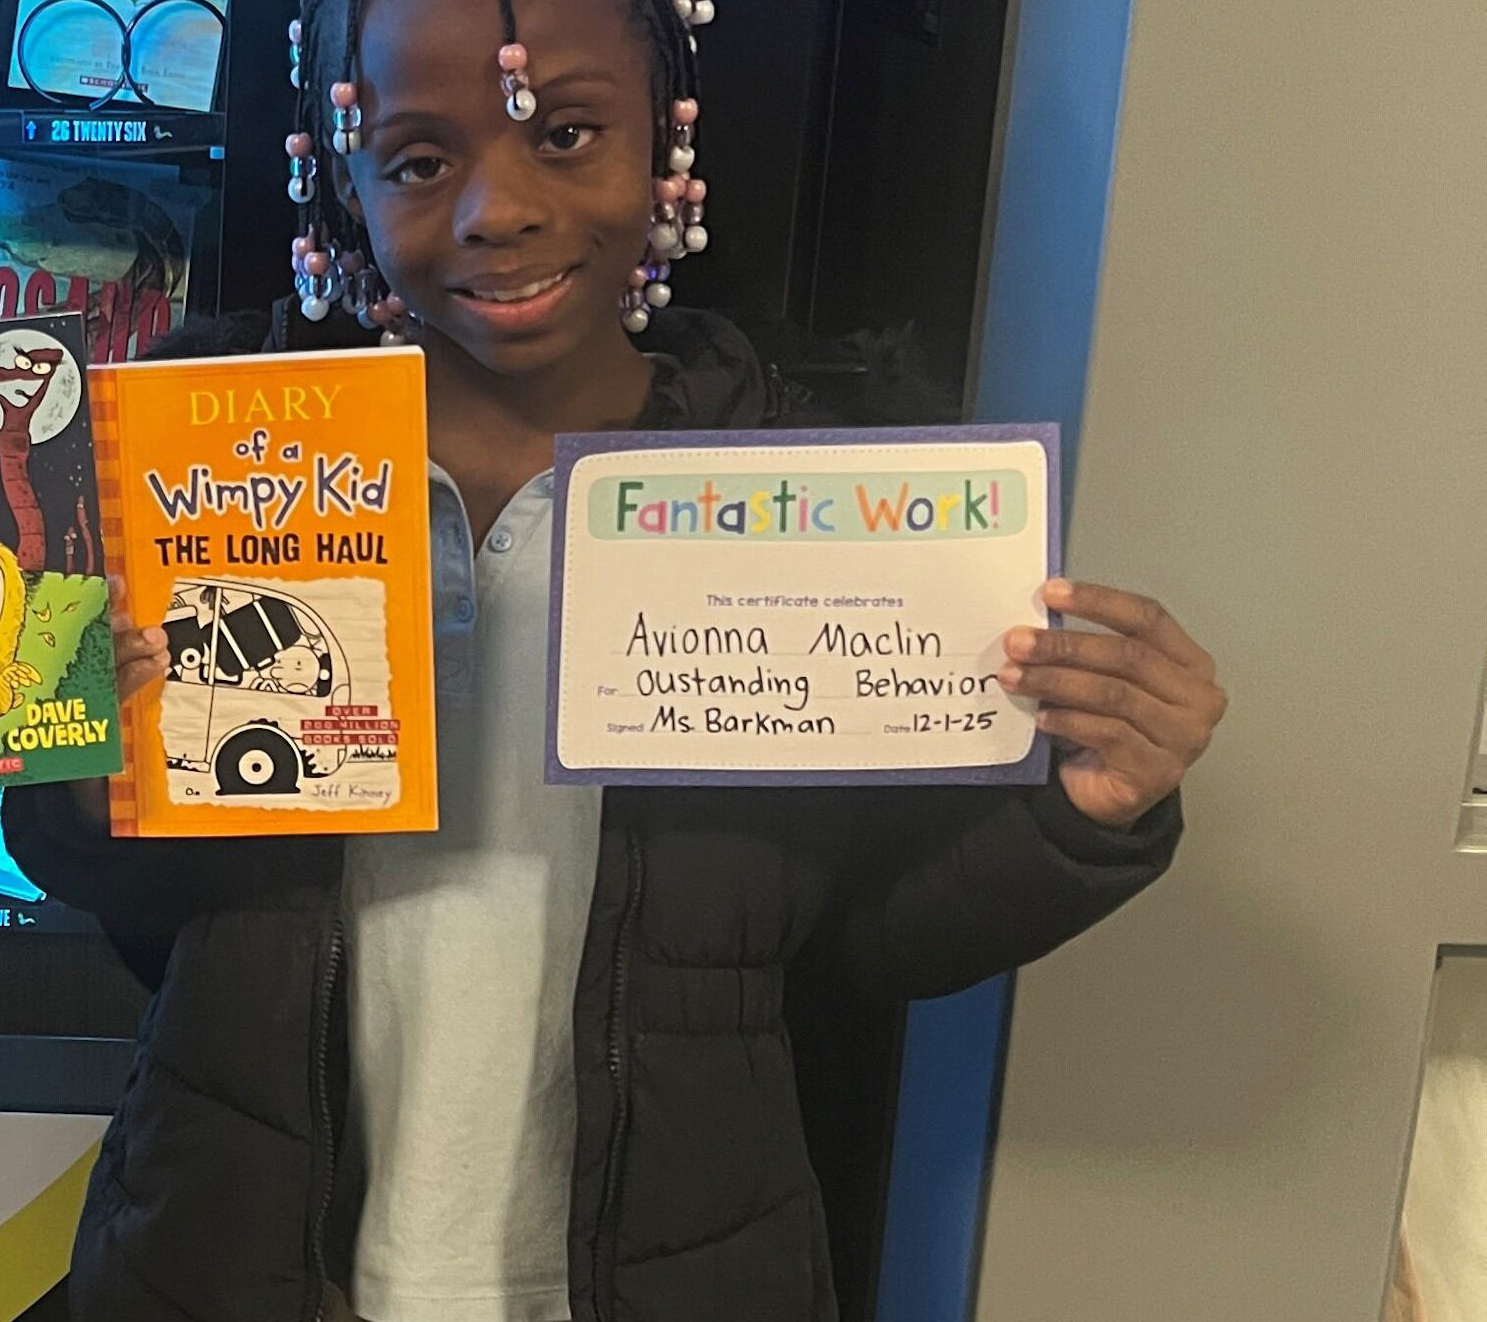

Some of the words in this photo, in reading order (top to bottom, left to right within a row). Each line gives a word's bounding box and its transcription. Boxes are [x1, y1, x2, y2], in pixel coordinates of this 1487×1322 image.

[51, 120, 71, 143] 26
[73, 120, 125, 143] TWENTY
[124, 120, 148, 143] SIX
[189, 384, 343, 426] DIARY
[234, 429, 269, 460] of
[281, 442, 301, 460] a
[148, 468, 304, 528] Wimpy
[316, 457, 390, 514] Kid
[616, 479, 836, 536] Fantastic
[854, 479, 1001, 534] Work!
[154, 535, 212, 567] THE
[226, 532, 300, 565] LONG
[317, 531, 389, 564] HAUL
[706, 594, 733, 608] This
[737, 594, 820, 608] certificate
[823, 594, 904, 608] celebrates
[626, 612, 770, 658] Avionna
[808, 621, 943, 658] Maclin
[596, 685, 619, 697] For
[636, 664, 811, 712] Oustanding
[855, 668, 1000, 700] Behavior
[25, 697, 87, 726] DAVE
[332, 706, 371, 716] OVER
[705, 707, 836, 737] Barkman
[912, 710, 998, 734] 12-1-25
[6, 717, 109, 753] COVERLY
[339, 720, 399, 730] MILLION
[605, 721, 645, 735] Signed
[883, 723, 912, 736] Date
[303, 734, 351, 744] BOOKS
[358, 734, 397, 744] SOLD
[311, 783, 342, 798] Jeff
[348, 783, 392, 805] Kinney
